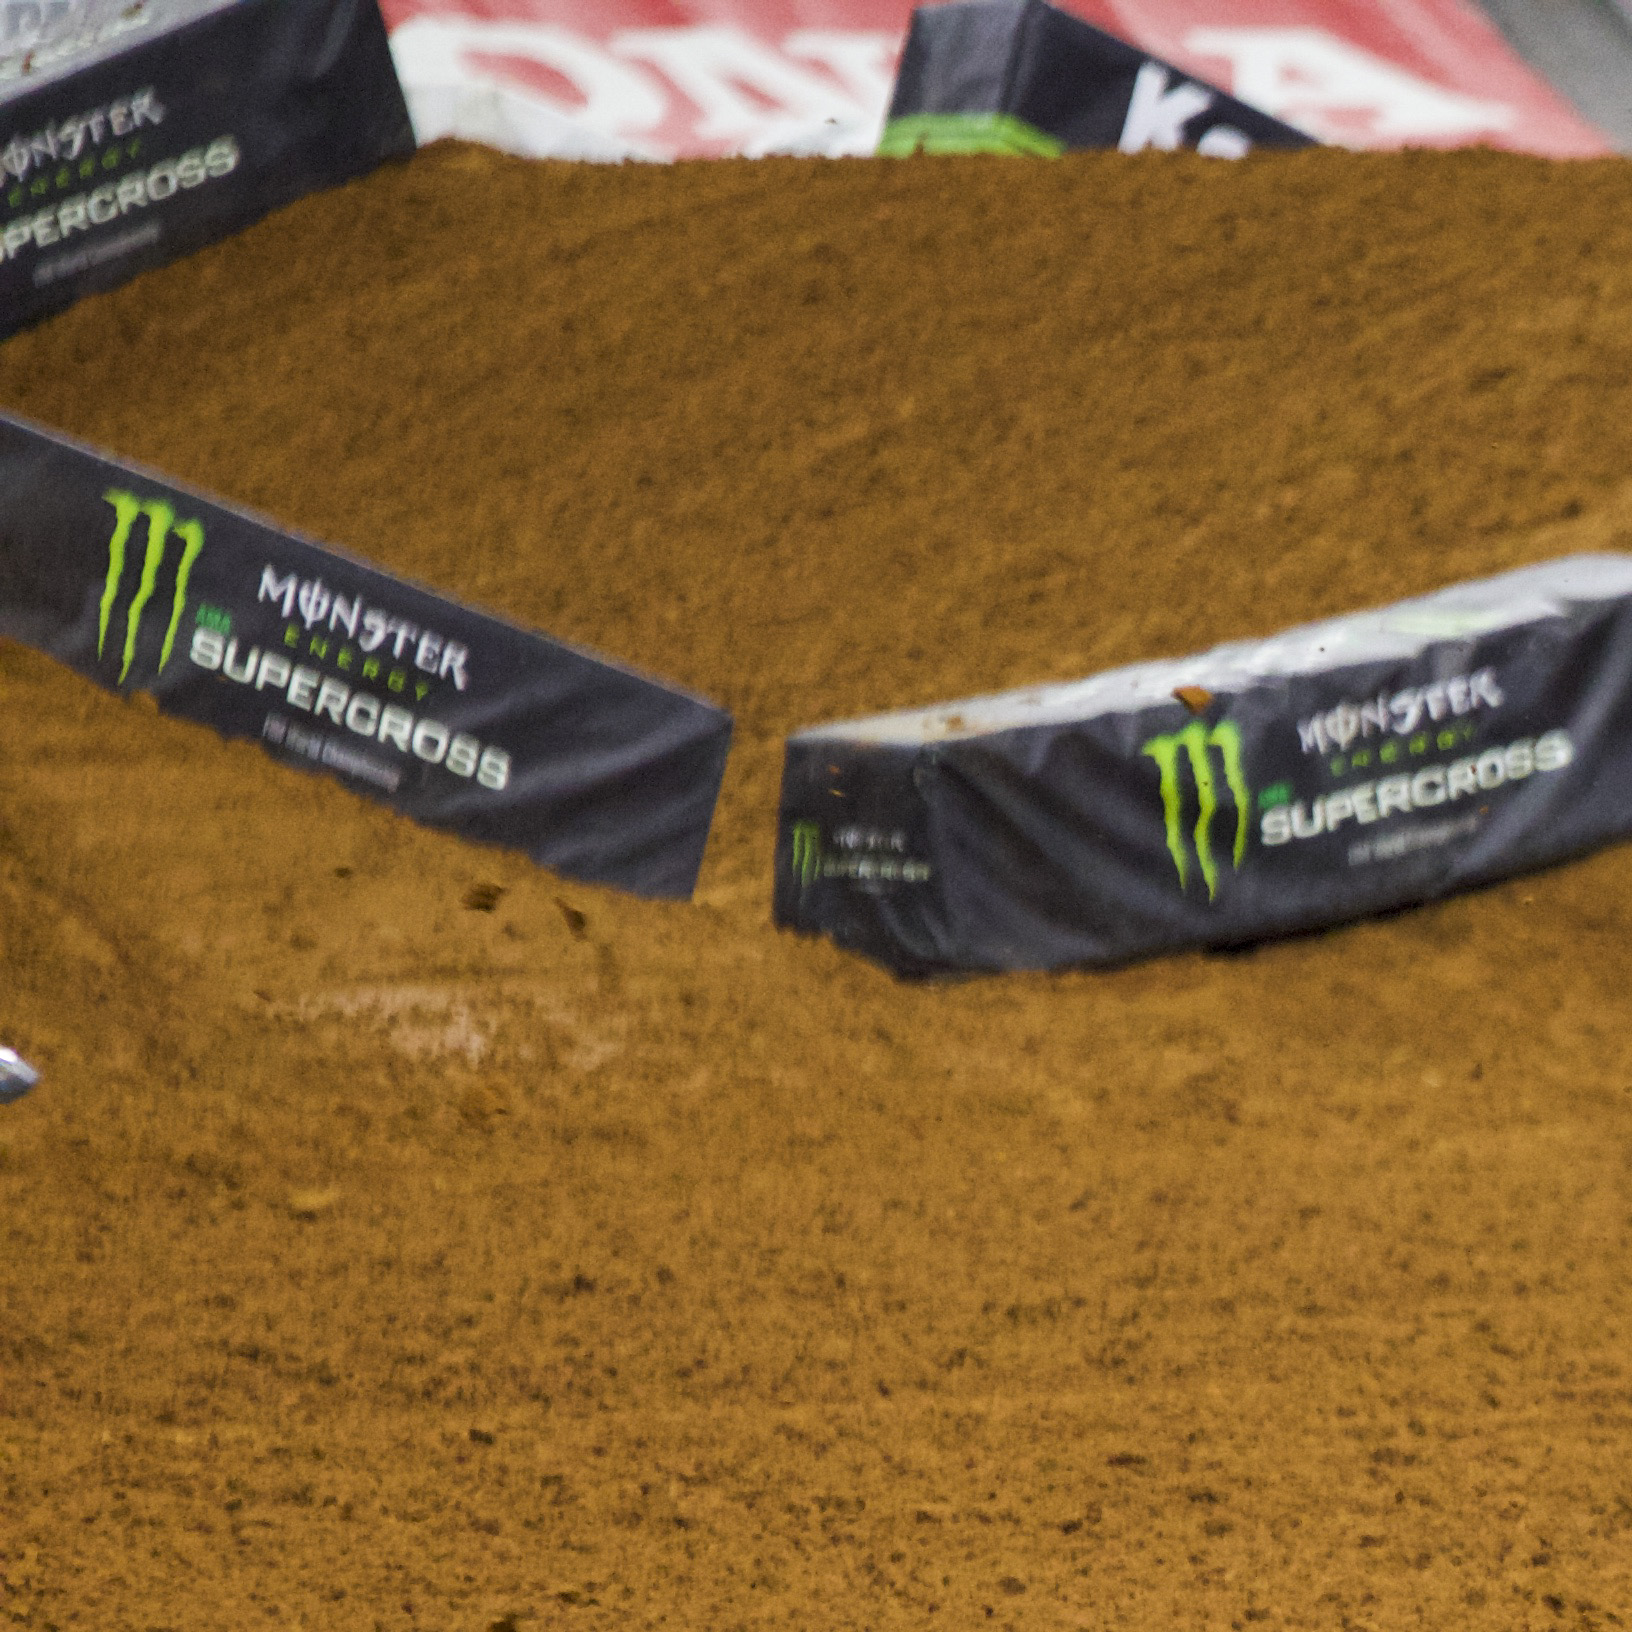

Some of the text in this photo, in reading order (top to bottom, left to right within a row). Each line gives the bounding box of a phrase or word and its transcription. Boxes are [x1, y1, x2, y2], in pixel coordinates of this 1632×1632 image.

[0, 85, 165, 190] ONSTER
[0, 134, 240, 263] PERCROSS
[257, 564, 469, 691] MONSTER
[189, 625, 512, 791] SUPERCROSS
[1297, 666, 1503, 755] MONSTER
[1260, 728, 1574, 846] SUPERCROSS
